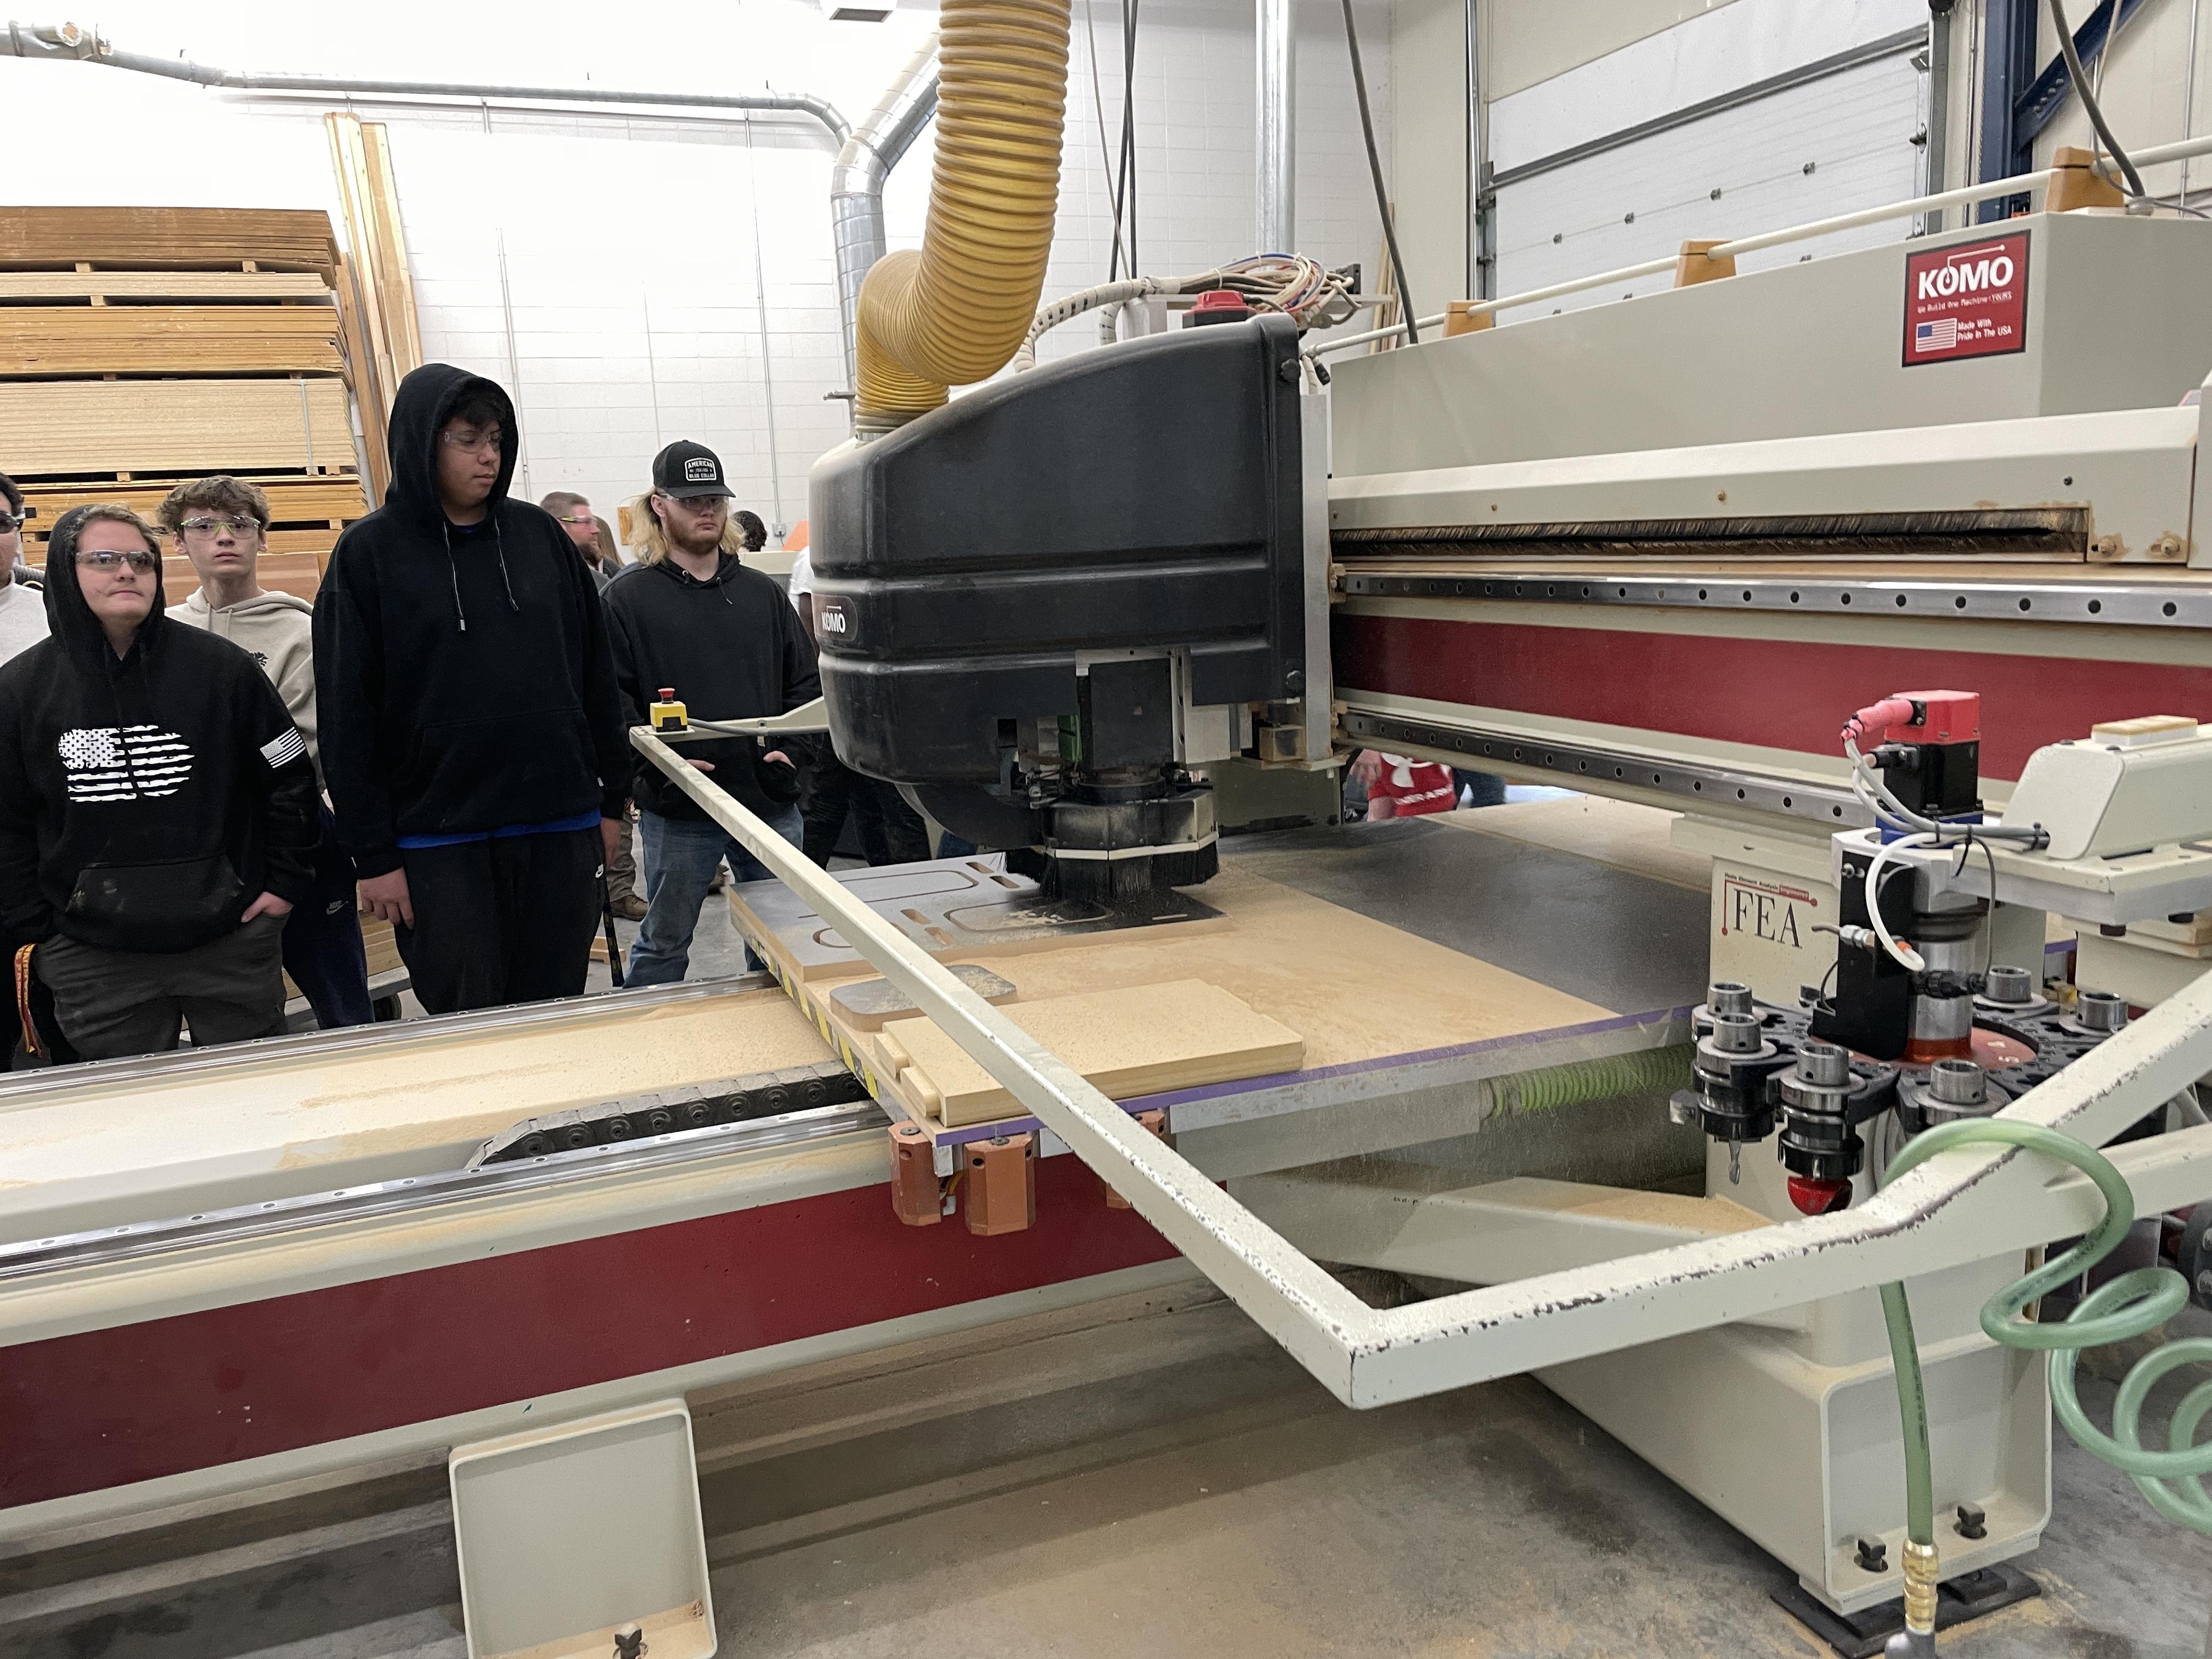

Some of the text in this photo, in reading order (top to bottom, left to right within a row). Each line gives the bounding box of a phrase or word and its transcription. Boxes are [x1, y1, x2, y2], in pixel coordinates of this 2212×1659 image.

[1918, 256, 2013, 300] KOMO
[1957, 318, 1992, 331] Made With
[1957, 325, 2012, 342] Pride In The USA
[688, 460, 713, 469] AMERICAN
[821, 611, 845, 633] KOMO
[1734, 887, 1803, 950] FEA
